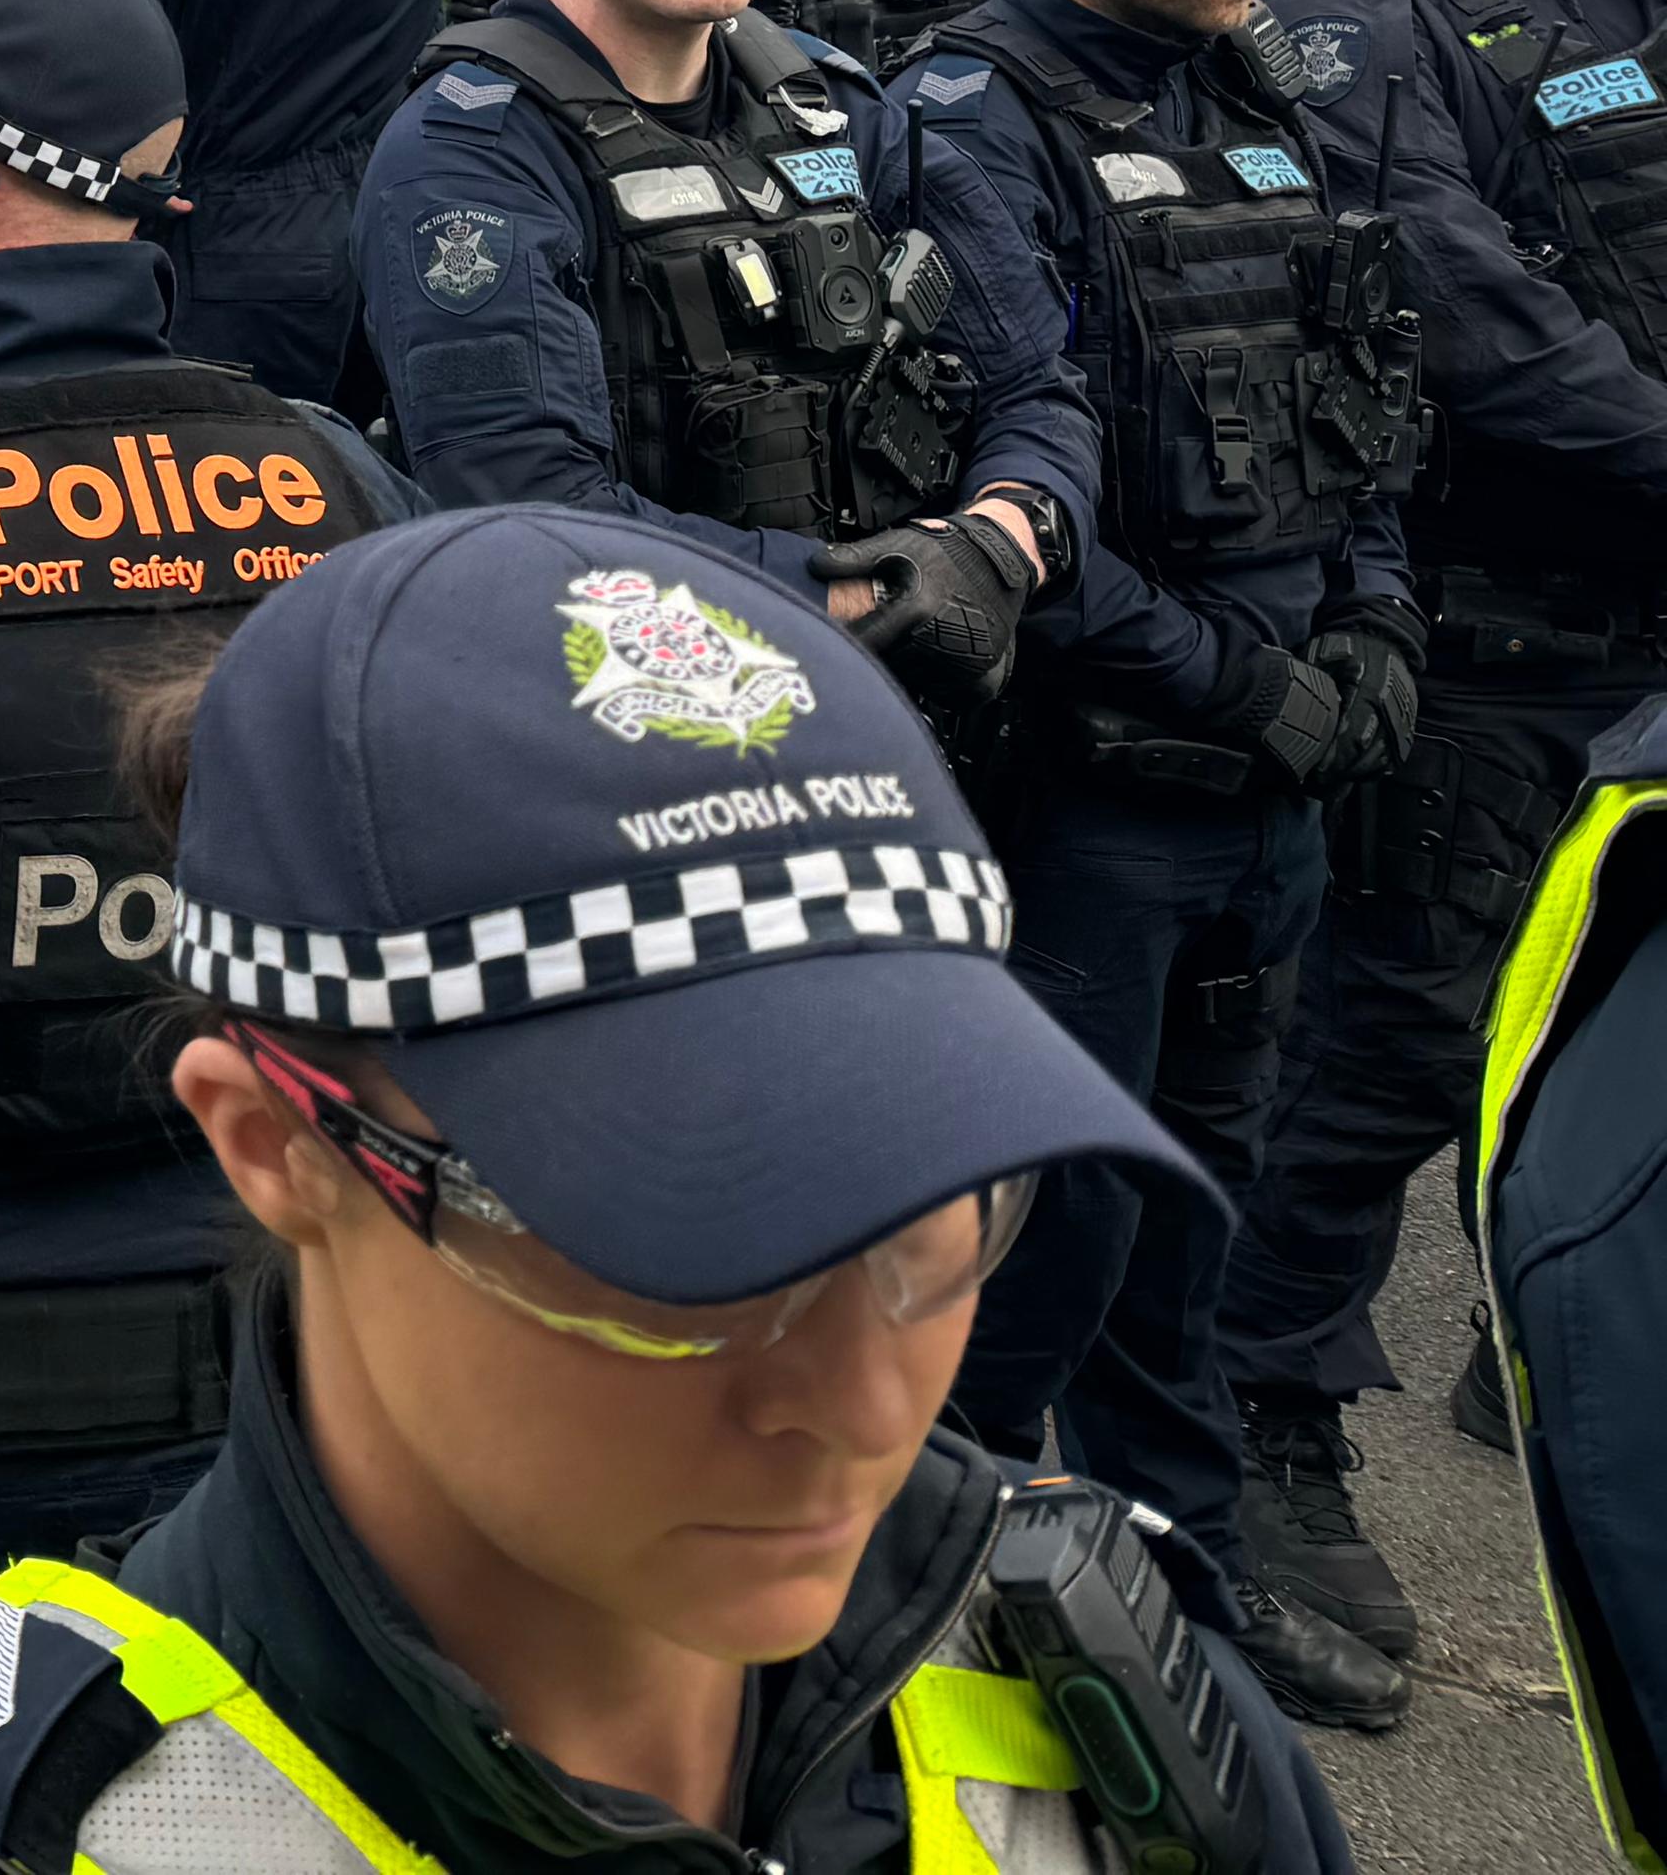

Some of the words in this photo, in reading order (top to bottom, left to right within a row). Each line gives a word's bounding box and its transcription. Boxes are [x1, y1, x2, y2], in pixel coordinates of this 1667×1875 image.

[1327, 22, 1360, 35] POLICE
[1539, 66, 1640, 104] Police
[780, 148, 859, 176] Police
[1228, 149, 1288, 171] Police
[416, 210, 463, 234] VICTORIA
[466, 210, 505, 227] POLICE
[109, 554, 204, 593] Safety
[233, 545, 329, 582] Offic
[618, 784, 809, 852] VICTORIA
[805, 774, 915, 819] POLICE
